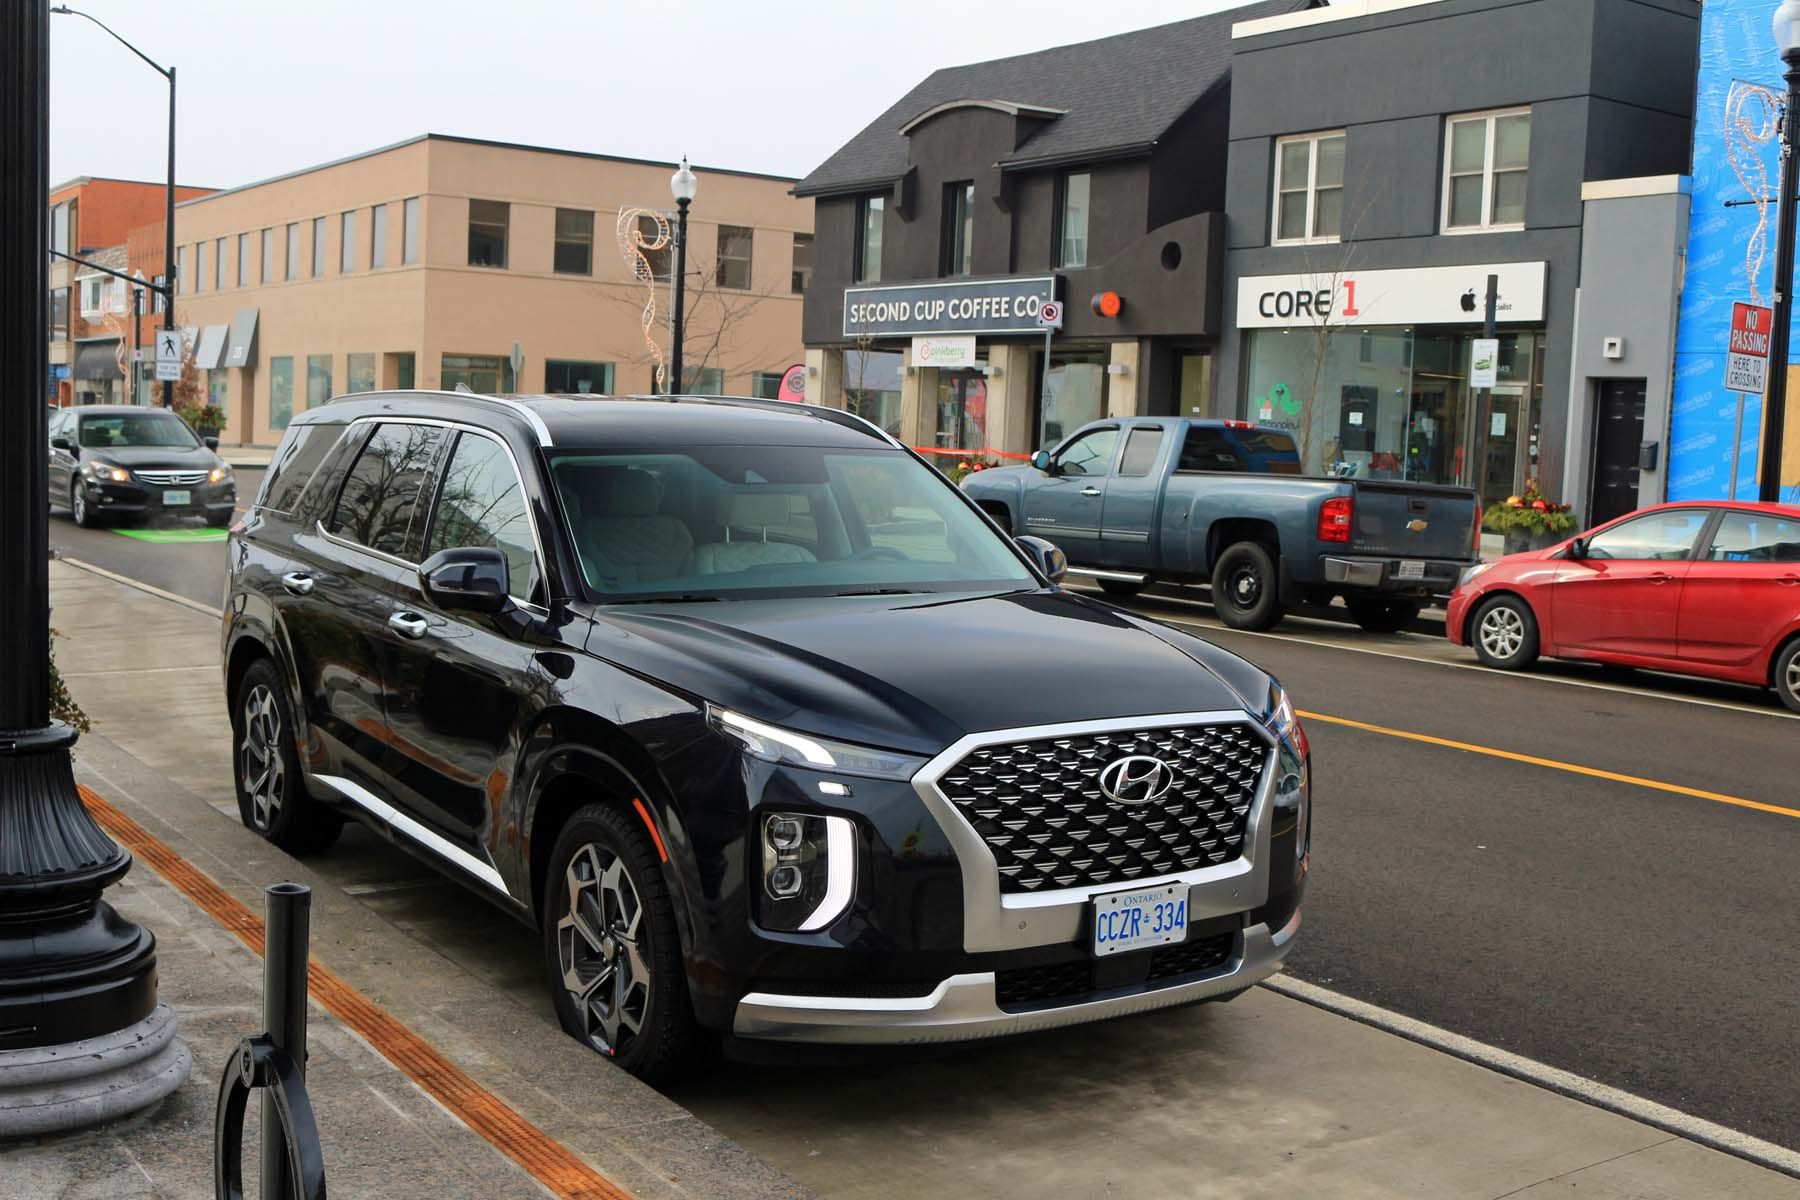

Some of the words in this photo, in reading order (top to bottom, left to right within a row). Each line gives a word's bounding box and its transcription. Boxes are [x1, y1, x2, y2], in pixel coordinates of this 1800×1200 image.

[850, 302, 910, 324] SECOND
[914, 300, 945, 321] CUP
[948, 296, 1010, 320] COFFEE
[1259, 290, 1331, 318] CORE
[1342, 281, 1359, 316] 1
[1745, 310, 1758, 329] NO
[1732, 330, 1767, 353] PASSING
[1733, 356, 1750, 372] HERE
[1753, 359, 1761, 373] TO
[1730, 371, 1762, 388] CROSSING
[1098, 907, 1142, 943] CCZR
[1152, 899, 1185, 933] 334
